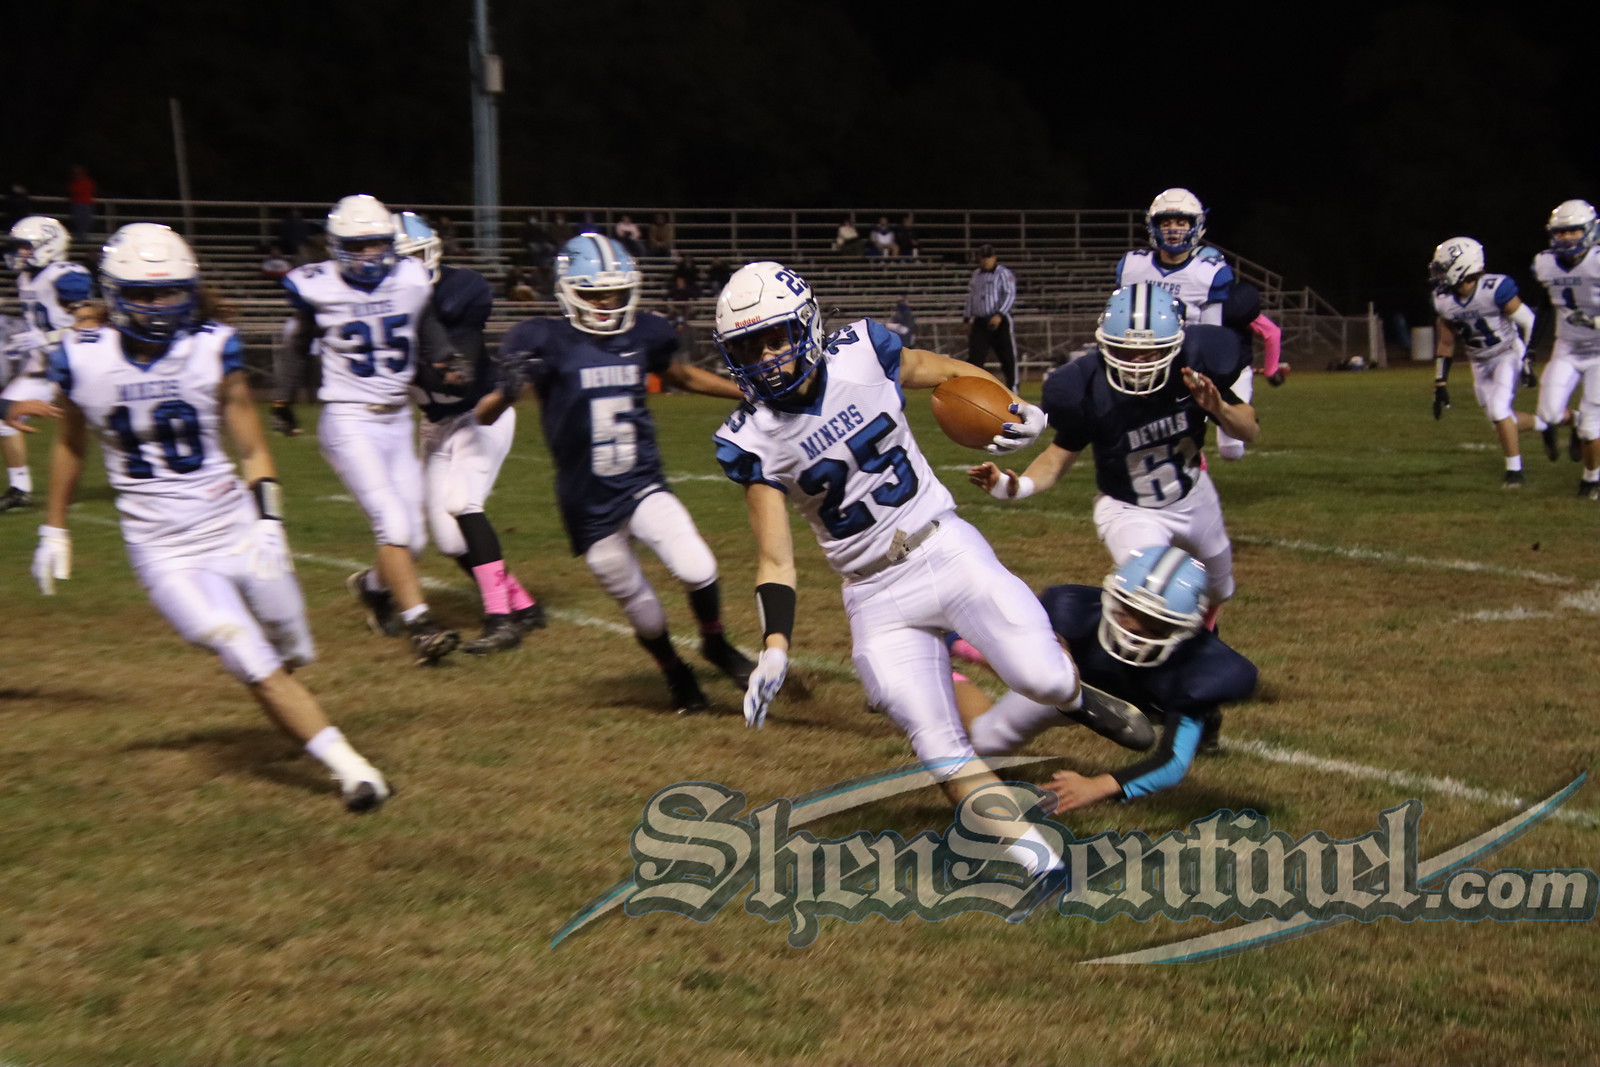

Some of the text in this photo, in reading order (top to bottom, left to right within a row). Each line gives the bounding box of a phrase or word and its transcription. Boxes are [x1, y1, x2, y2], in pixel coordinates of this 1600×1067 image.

[775, 266, 809, 297] 25
[340, 313, 410, 378] 35
[734, 315, 762, 329] Riddell
[108, 400, 205, 480] 10
[590, 395, 637, 477] 5
[799, 403, 865, 461] MINERS
[1127, 410, 1188, 451] DEVILS
[797, 411, 919, 540] 25
